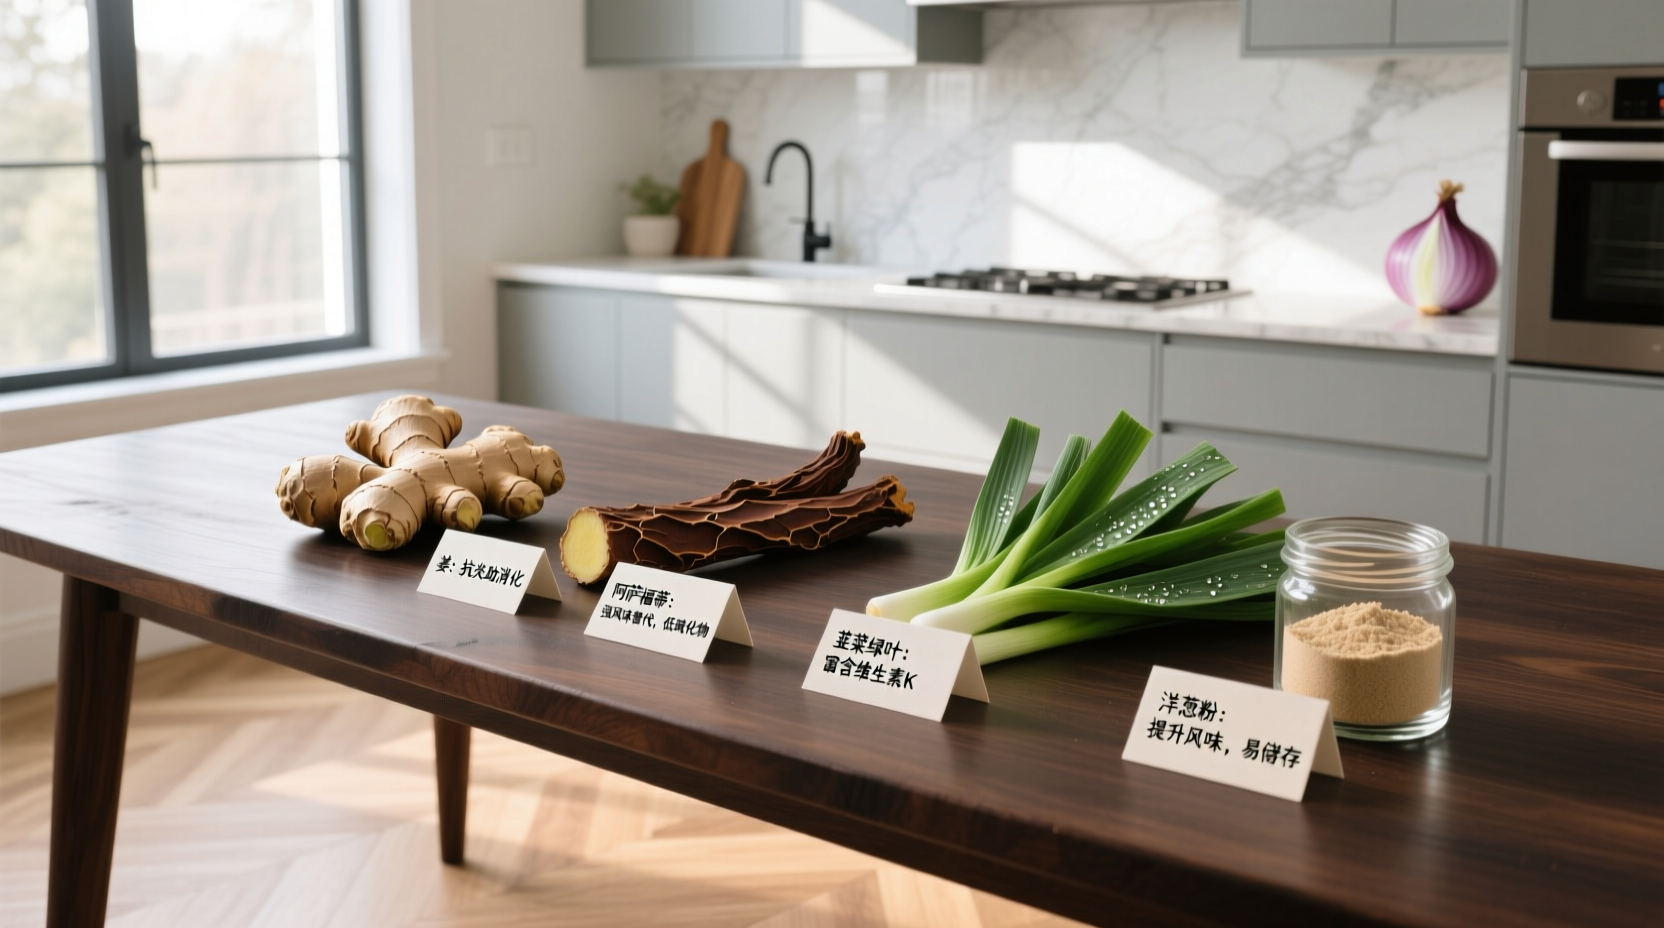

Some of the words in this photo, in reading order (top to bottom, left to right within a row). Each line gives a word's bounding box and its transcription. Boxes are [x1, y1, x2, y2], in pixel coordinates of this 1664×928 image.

[833, 629, 909, 661] 韭菜绿叶：
[1158, 691, 1226, 722] 洋葱粉：
